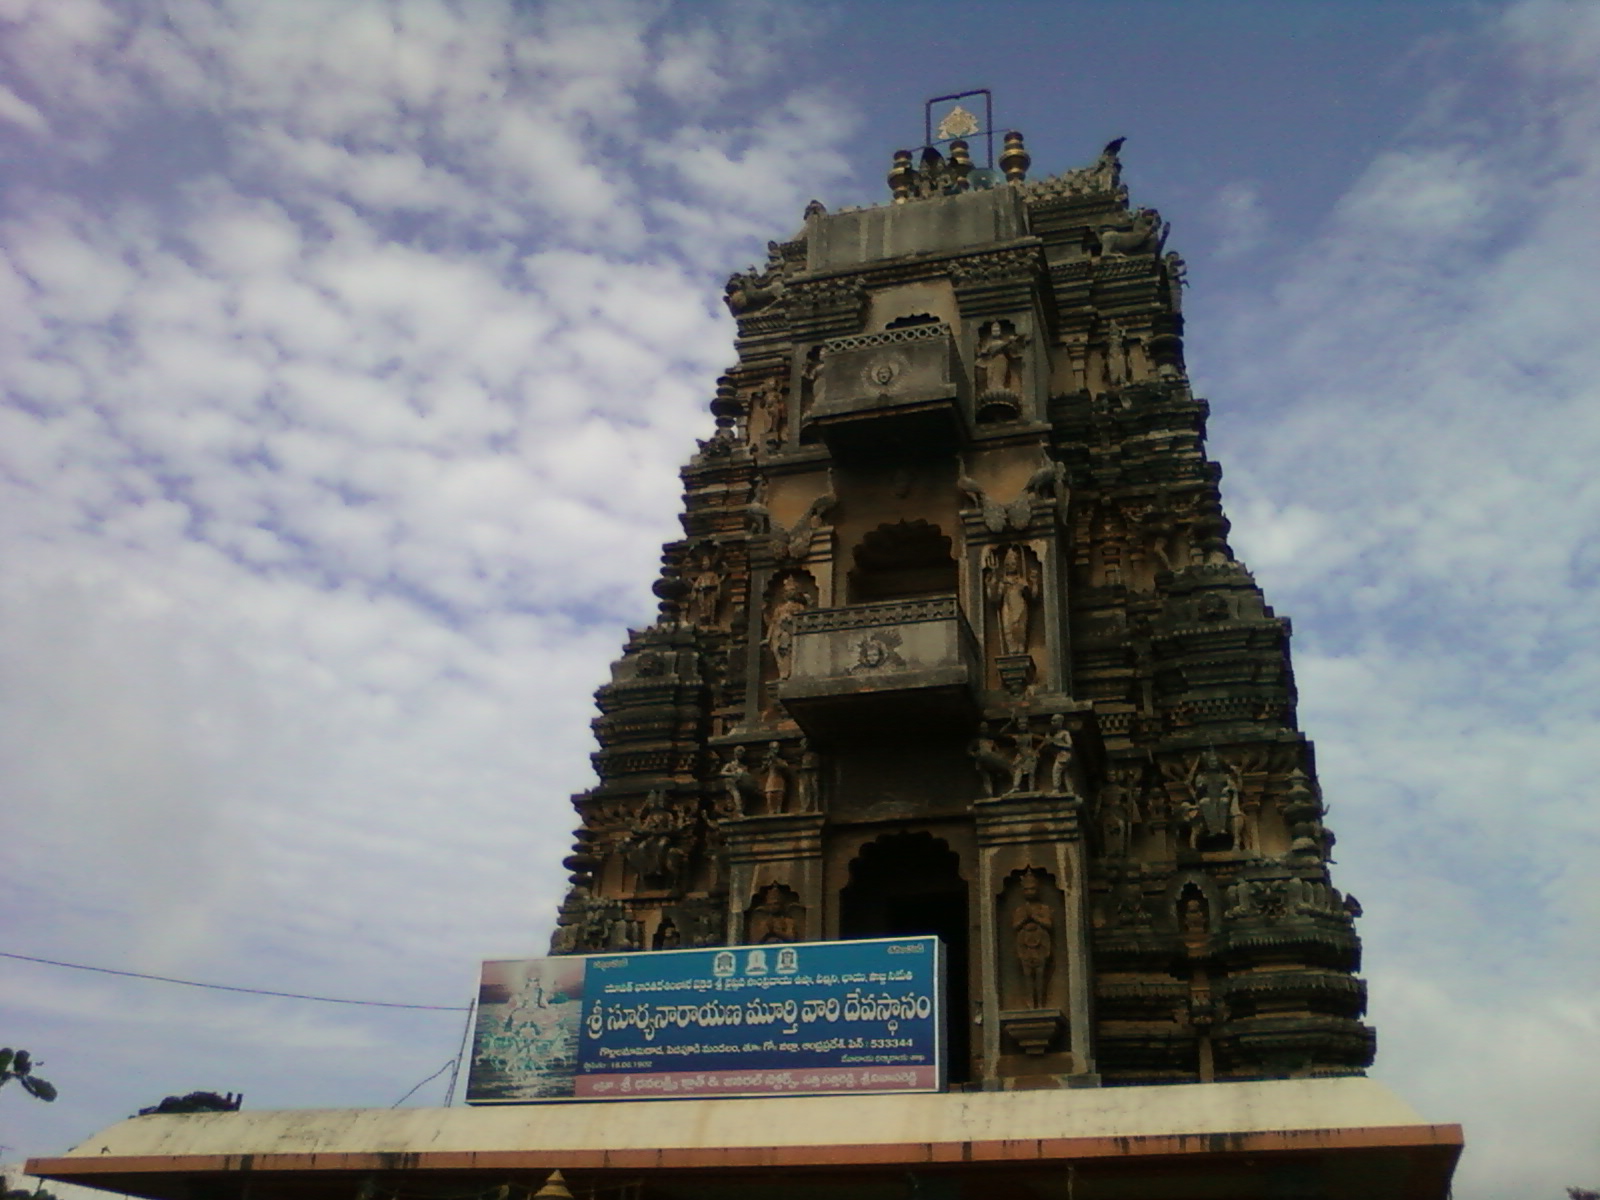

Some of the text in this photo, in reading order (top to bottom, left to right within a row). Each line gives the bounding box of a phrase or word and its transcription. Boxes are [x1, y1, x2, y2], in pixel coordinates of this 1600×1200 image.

[714, 977, 722, 991] శ్రీ
[586, 987, 931, 1041] శ్రీ సూర్యనారాయణ మూర్తి వారి దేవస్థానం
[870, 1038, 913, 1049] 533344
